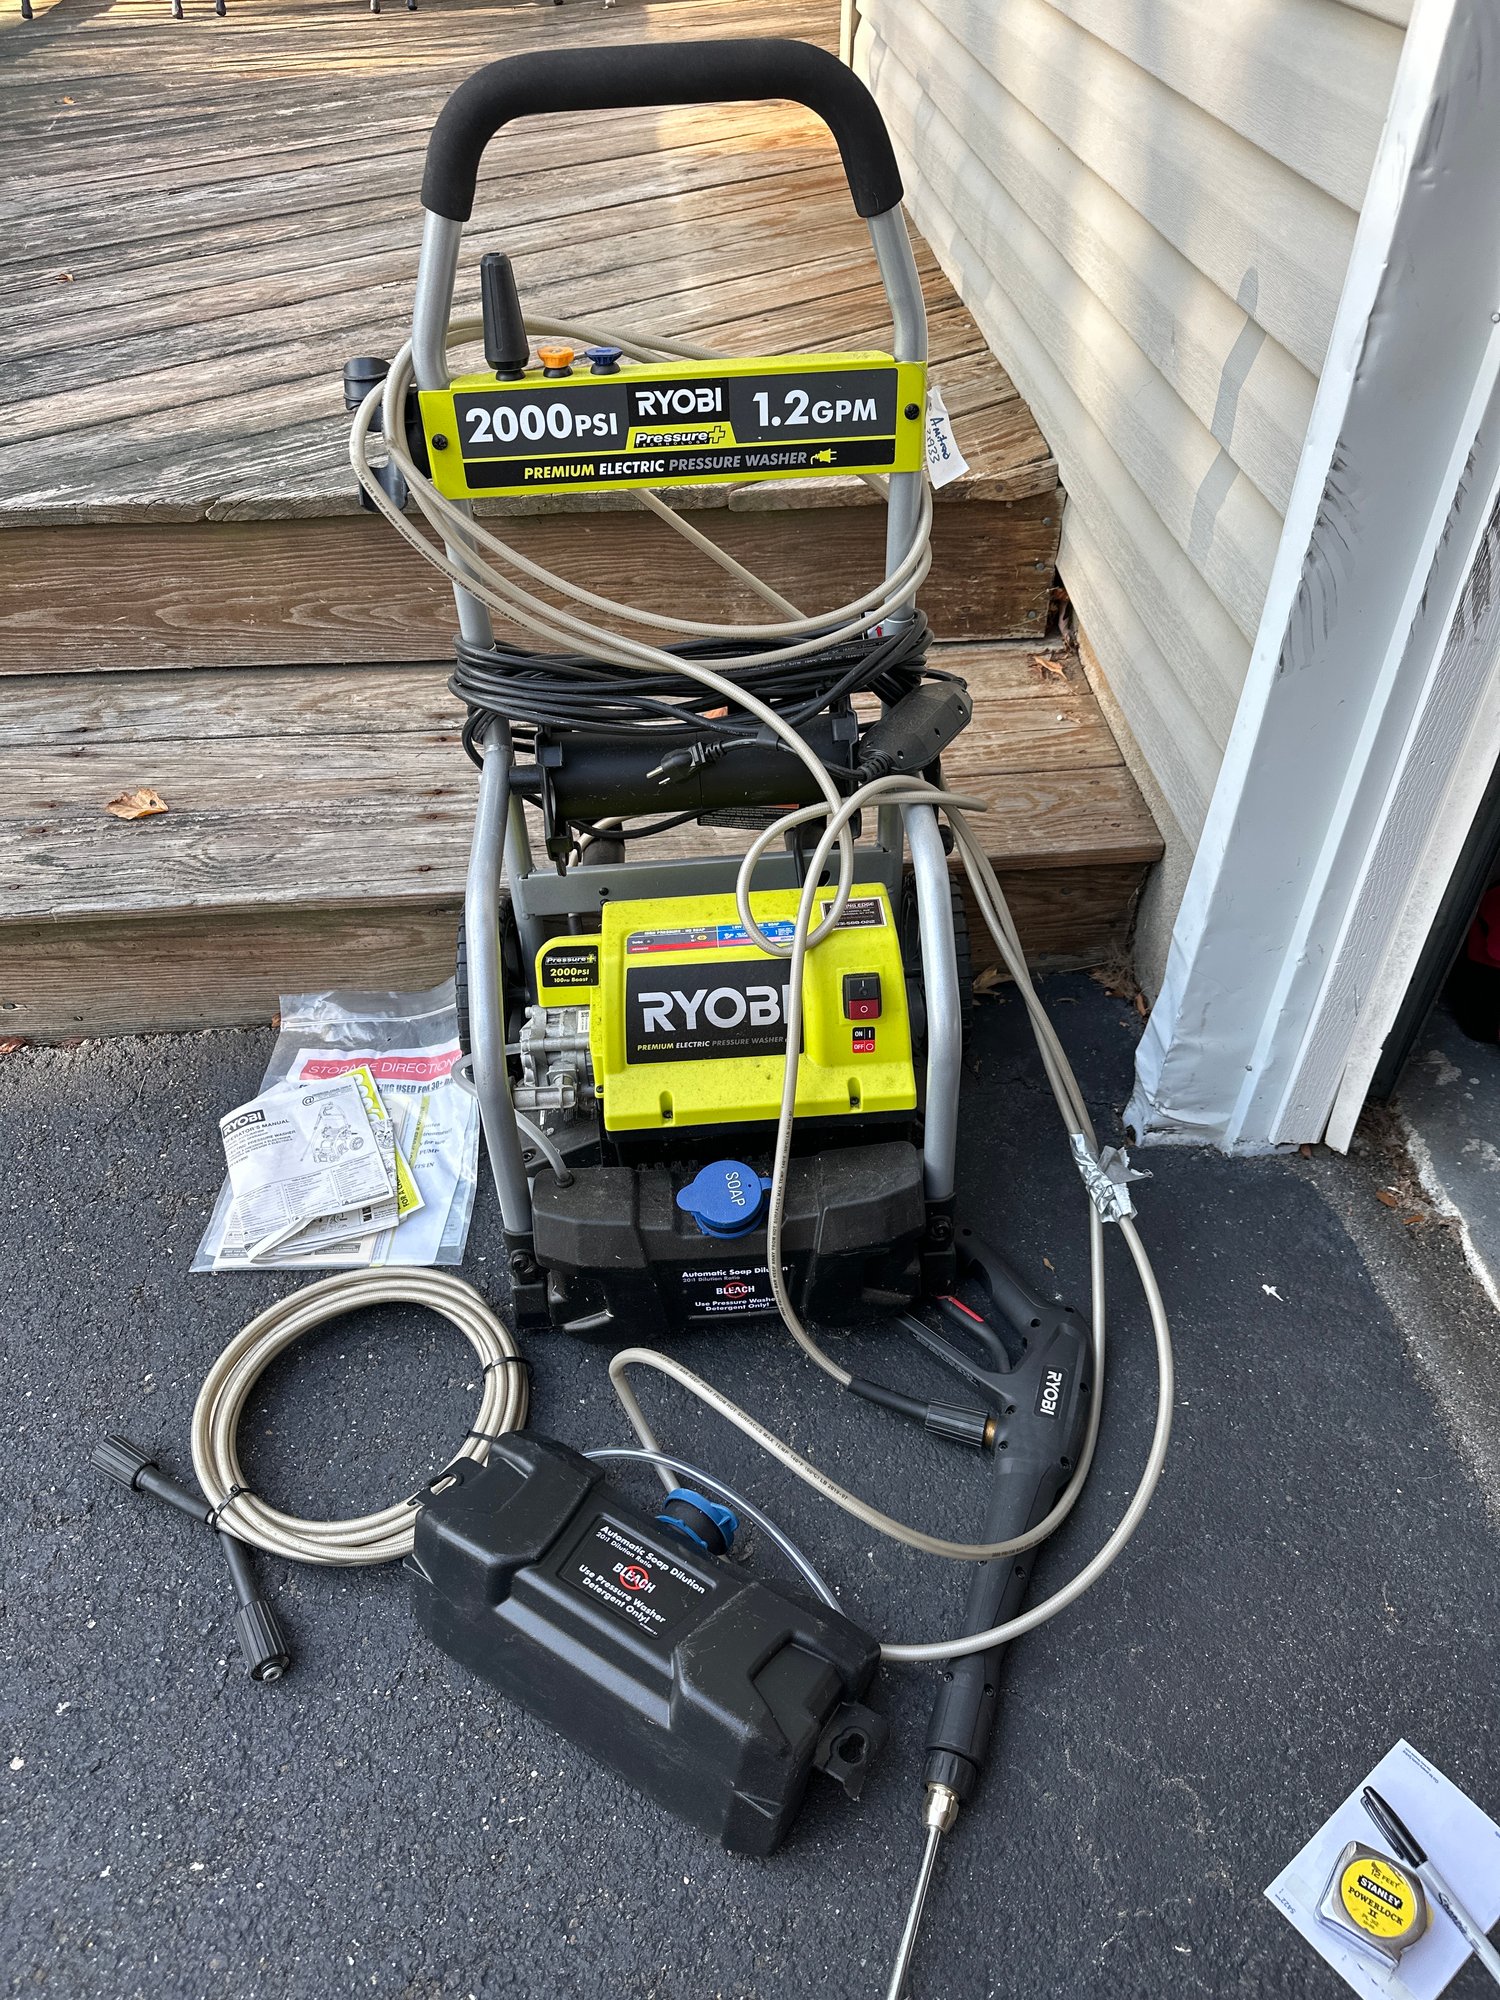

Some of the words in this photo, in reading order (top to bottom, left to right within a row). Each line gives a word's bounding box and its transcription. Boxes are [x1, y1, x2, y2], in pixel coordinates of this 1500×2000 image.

[635, 387, 722, 417] RYOBI
[524, 463, 595, 480] PREMIUM
[599, 459, 665, 476] ELECTRIC
[668, 455, 742, 472] PRESSURE
[745, 451, 807, 467] WASHER
[637, 1042, 674, 1051] PREMIUM
[676, 1040, 711, 1050] ELECTRIC
[712, 1038, 750, 1047] PRESSURE
[751, 1036, 784, 1044] WASHER
[396, 1084, 416, 1094] USED
[222, 1111, 263, 1137] RYOBI
[261, 1119, 290, 1128] MANUAL
[725, 1171, 747, 1207] SOAP
[682, 1269, 727, 1279] Automatic
[729, 1267, 752, 1277] Soap
[716, 1285, 755, 1295] BLEACH
[1040, 1370, 1063, 1416] RYOBI
[712, 1392, 727, 1405] FROM
[726, 1403, 737, 1413] HOT
[737, 1411, 763, 1434] SURFACES
[762, 1432, 774, 1444] MAX
[774, 1442, 789, 1455] TEMP
[595, 1531, 610, 1543] 20:1
[610, 1540, 635, 1558] Dilution
[635, 1555, 653, 1569] Ratio
[600, 1525, 646, 1556] Automatic
[645, 1552, 669, 1572] Soap
[670, 1567, 706, 1595] Dilution
[612, 1562, 657, 1594] BLEACH
[578, 1564, 596, 1579] Use
[595, 1573, 632, 1602] Pressure
[633, 1598, 667, 1624] Washer
[582, 1577, 625, 1608] Detergent
[625, 1604, 651, 1625] Only!
[1360, 1877, 1400, 1907] STANLEY
[1371, 1868, 1380, 1880] 12
[1381, 1874, 1400, 1888] FEET
[1347, 1885, 1404, 1927] POWERLOCK
[1368, 1908, 1378, 1919] II
